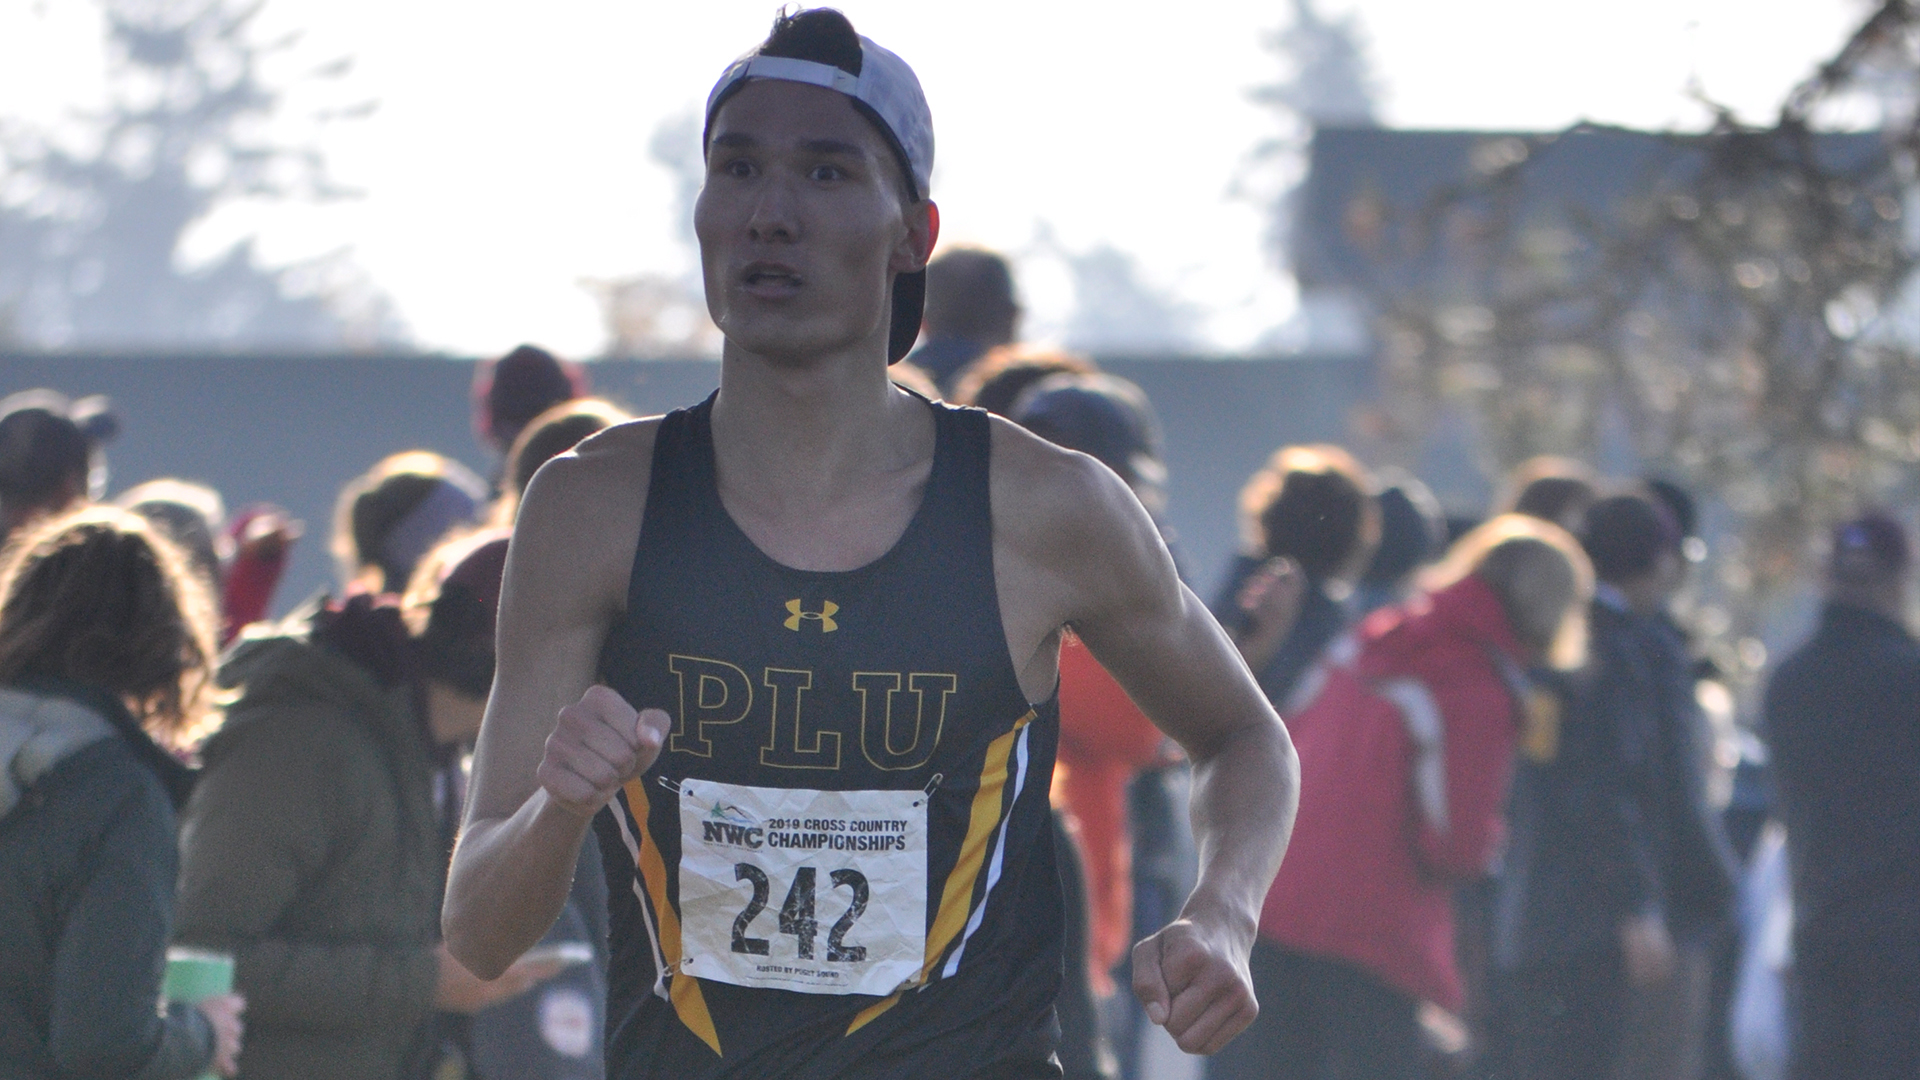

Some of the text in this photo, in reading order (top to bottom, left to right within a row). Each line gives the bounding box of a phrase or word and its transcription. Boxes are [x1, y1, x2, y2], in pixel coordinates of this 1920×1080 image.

[669, 654, 956, 771] PLU
[702, 821, 764, 849] NWC
[769, 818, 908, 832] 2019 CROSS COUNTRY
[768, 832, 906, 851] CHAMPIONSHIPS
[731, 862, 870, 961] 242
[756, 965, 782, 973] HOSTED
[784, 966, 793, 974] BY
